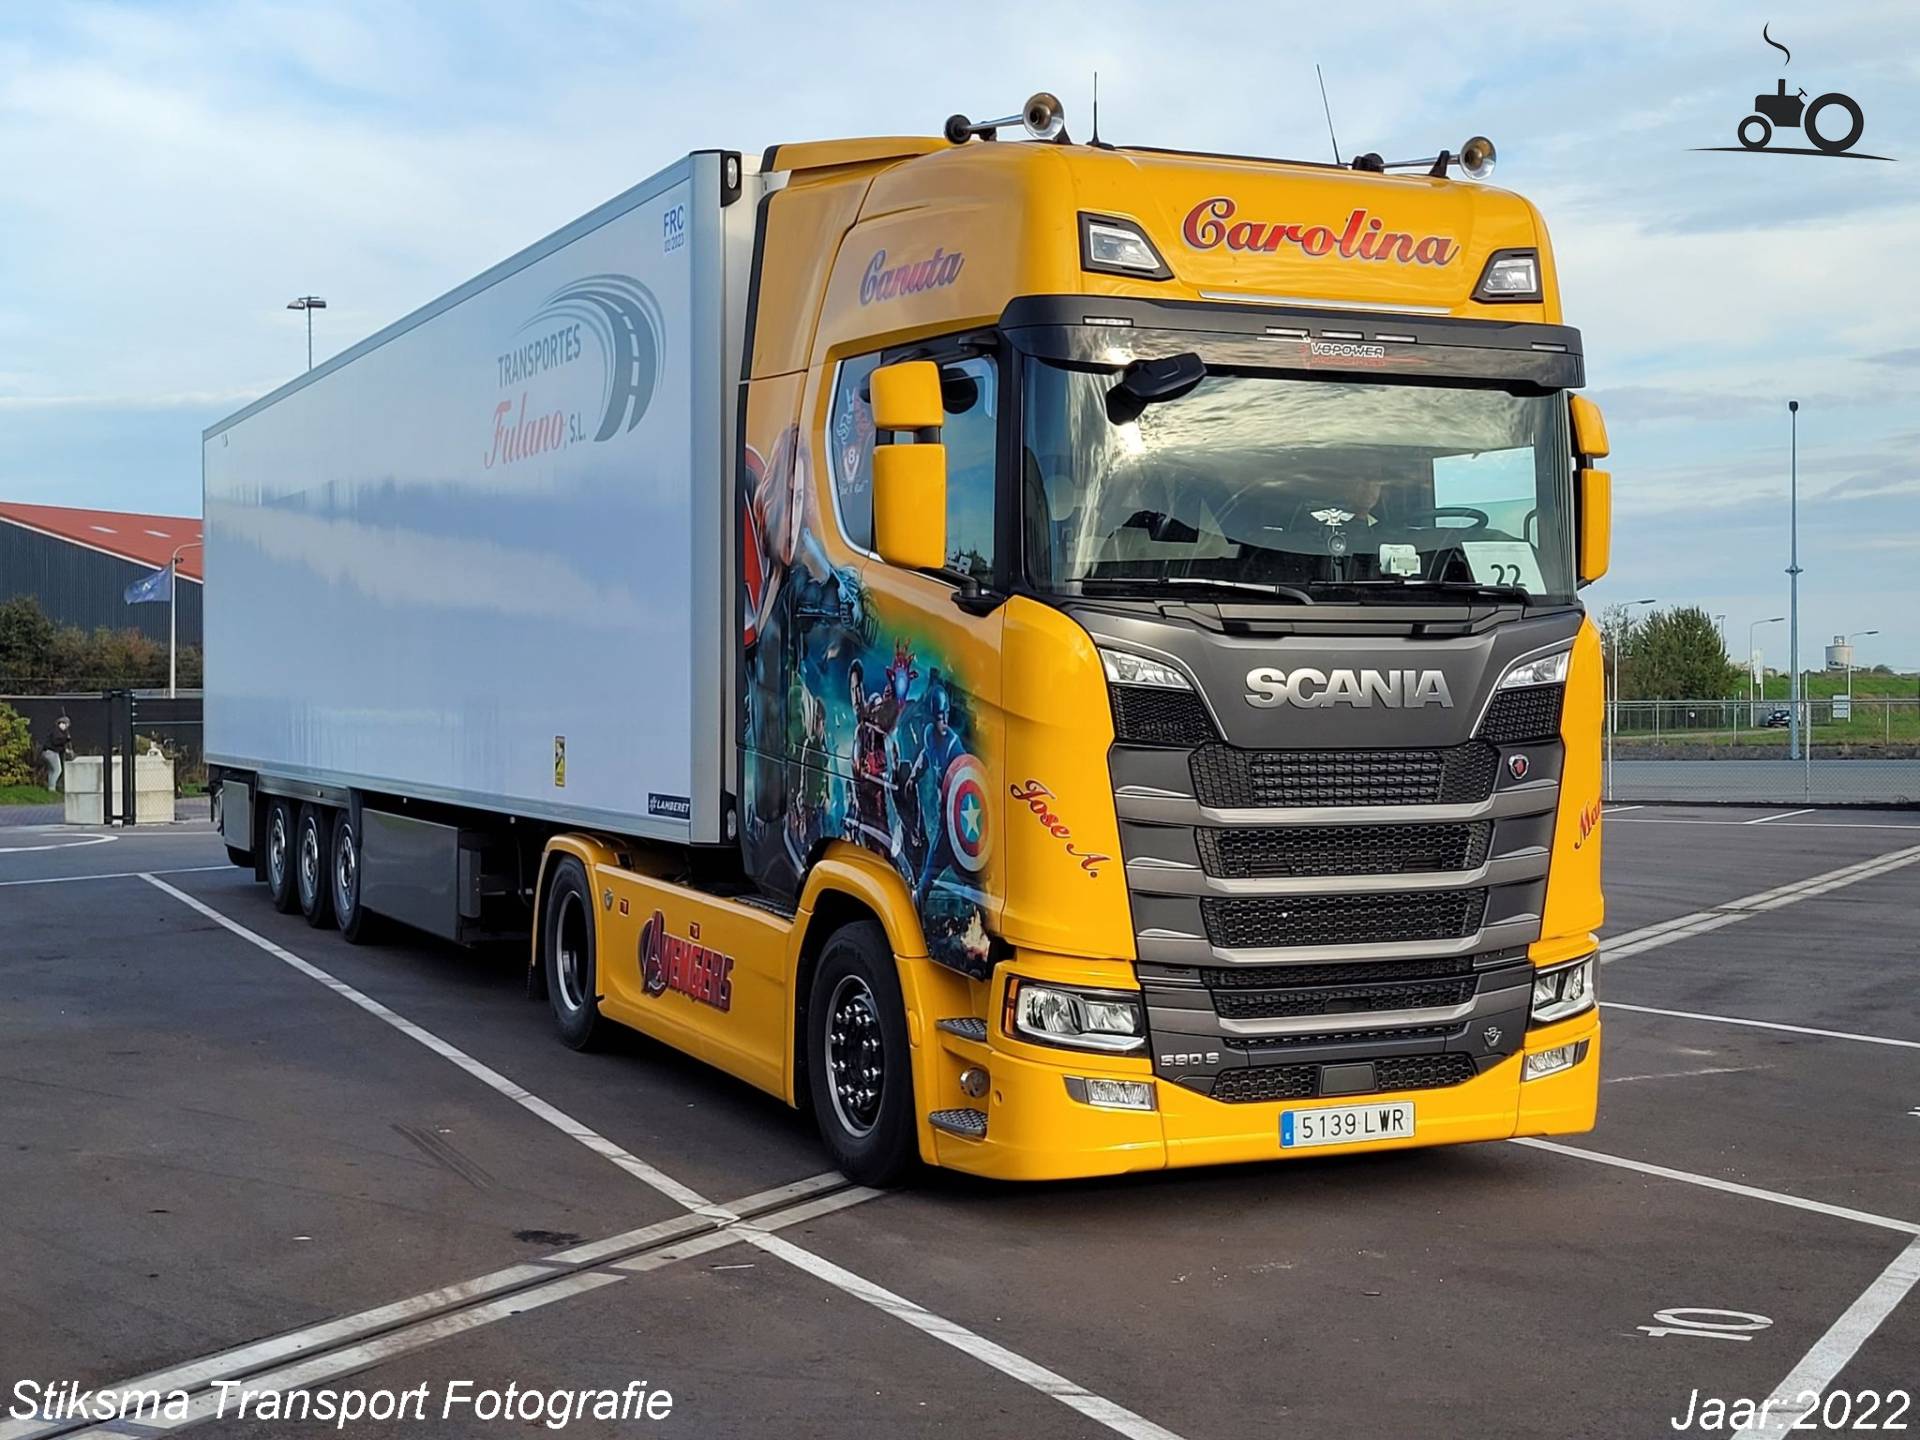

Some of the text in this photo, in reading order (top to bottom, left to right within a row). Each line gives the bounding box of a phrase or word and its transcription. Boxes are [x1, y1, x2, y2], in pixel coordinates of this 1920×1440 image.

[663, 205, 684, 238] FRC
[1181, 197, 1461, 268] Carolina
[859, 247, 966, 306] Canuta
[498, 323, 582, 389] TRANSPORTES
[1490, 564, 1526, 588] 22
[1244, 667, 1454, 710] SCANIA
[1010, 779, 1072, 839] Jose
[638, 910, 736, 1012] AVENGERS
[1160, 1051, 1219, 1067] 590 S
[1302, 1109, 1404, 1139] 5139 LWR
